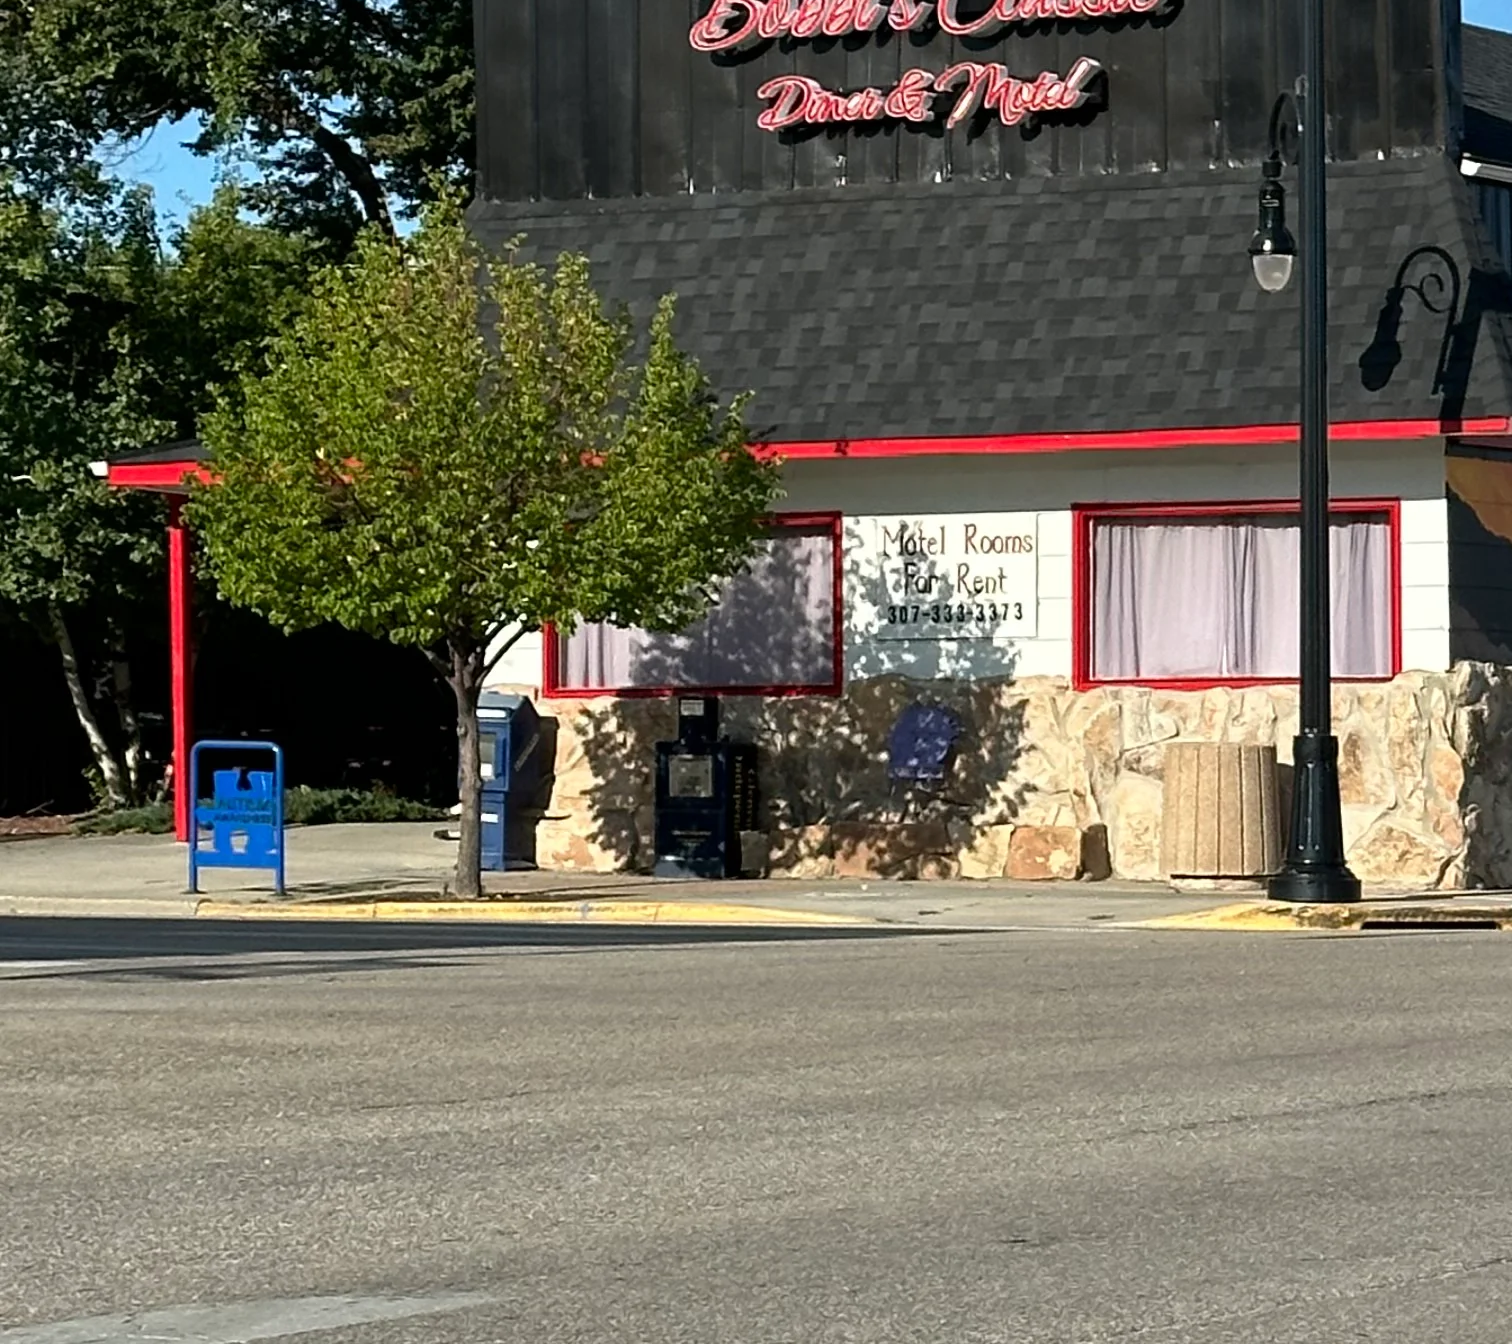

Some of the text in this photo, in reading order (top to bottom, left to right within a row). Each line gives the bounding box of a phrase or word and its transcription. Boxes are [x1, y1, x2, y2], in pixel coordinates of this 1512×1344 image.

[757, 56, 1099, 131] Diner & Motel
[882, 523, 1033, 556] Motel Rooms
[956, 562, 1007, 595] Rent
[887, 602, 1024, 625] 307-333-3373
